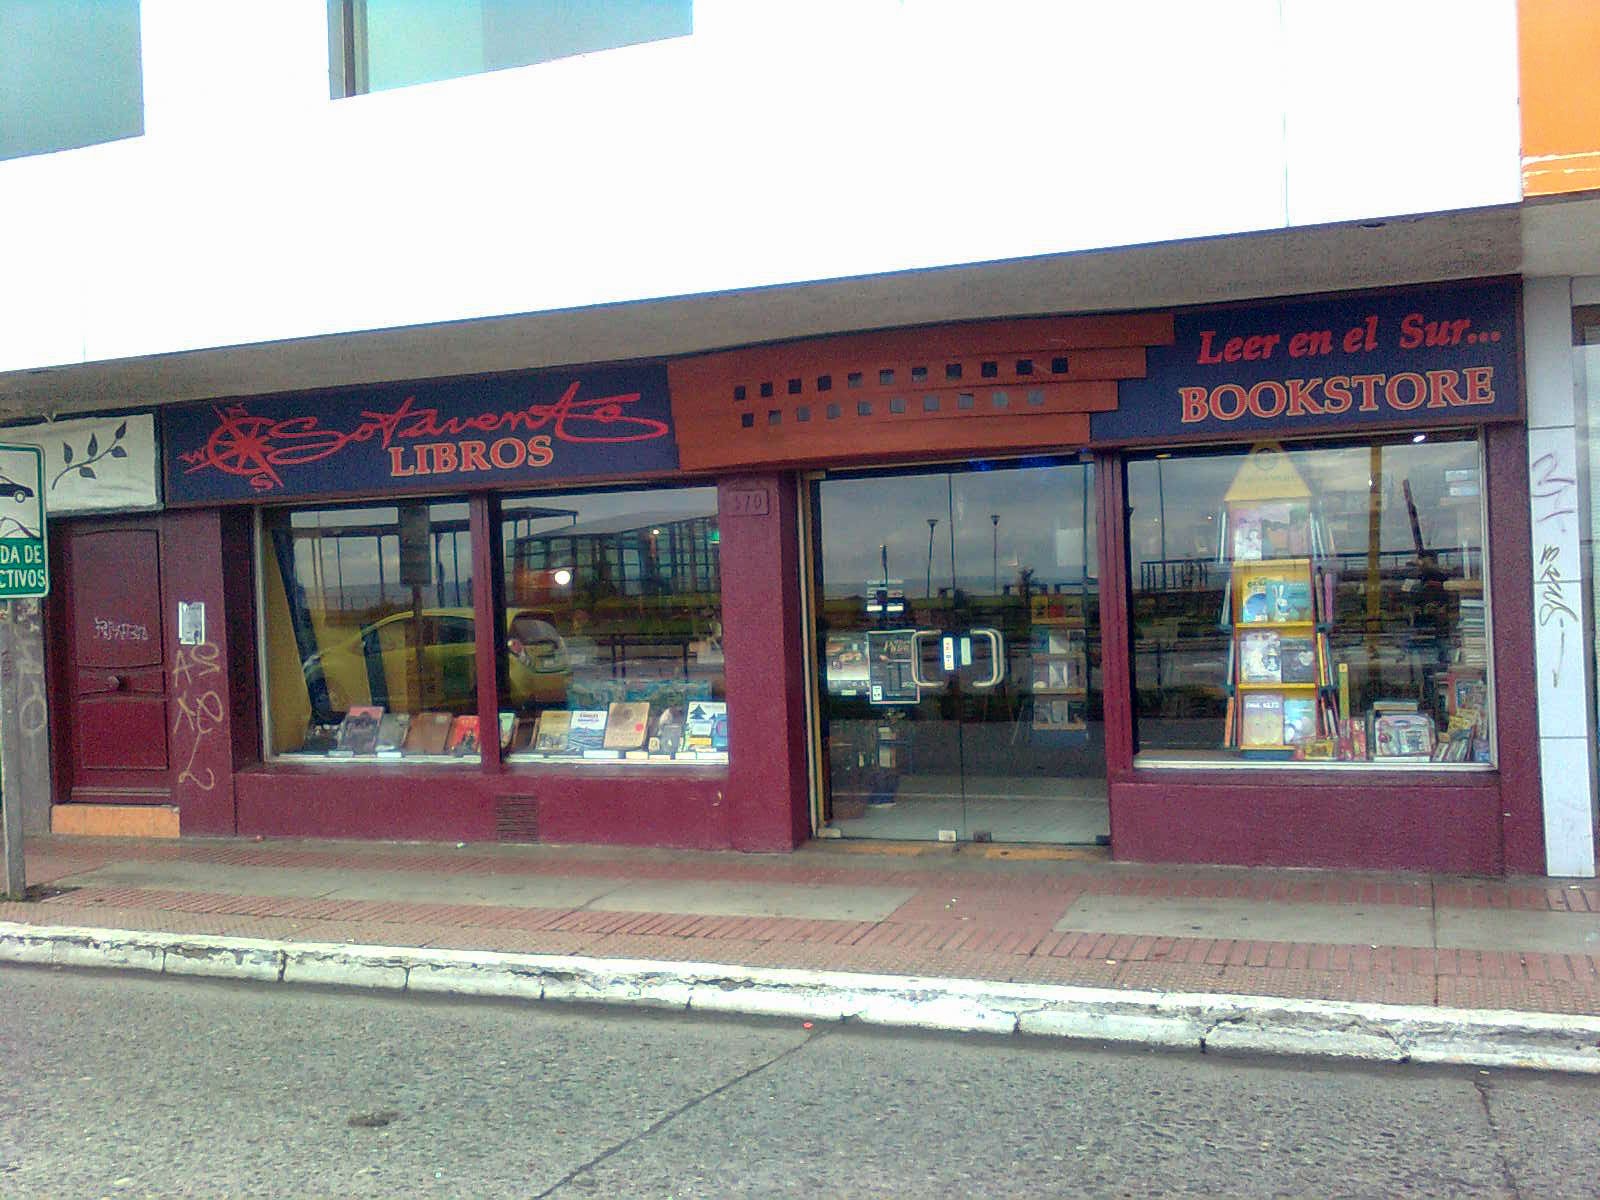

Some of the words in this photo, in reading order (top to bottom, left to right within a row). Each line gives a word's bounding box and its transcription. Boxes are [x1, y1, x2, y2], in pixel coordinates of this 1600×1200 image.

[1197, 330, 1280, 365] Leer
[1288, 330, 1333, 358] en
[1343, 316, 1378, 353] el
[1399, 313, 1502, 350] Sur...
[1178, 366, 1496, 423] BOOKSTORE
[388, 434, 554, 477] LIBROS
[24, 544, 43, 564] DE
